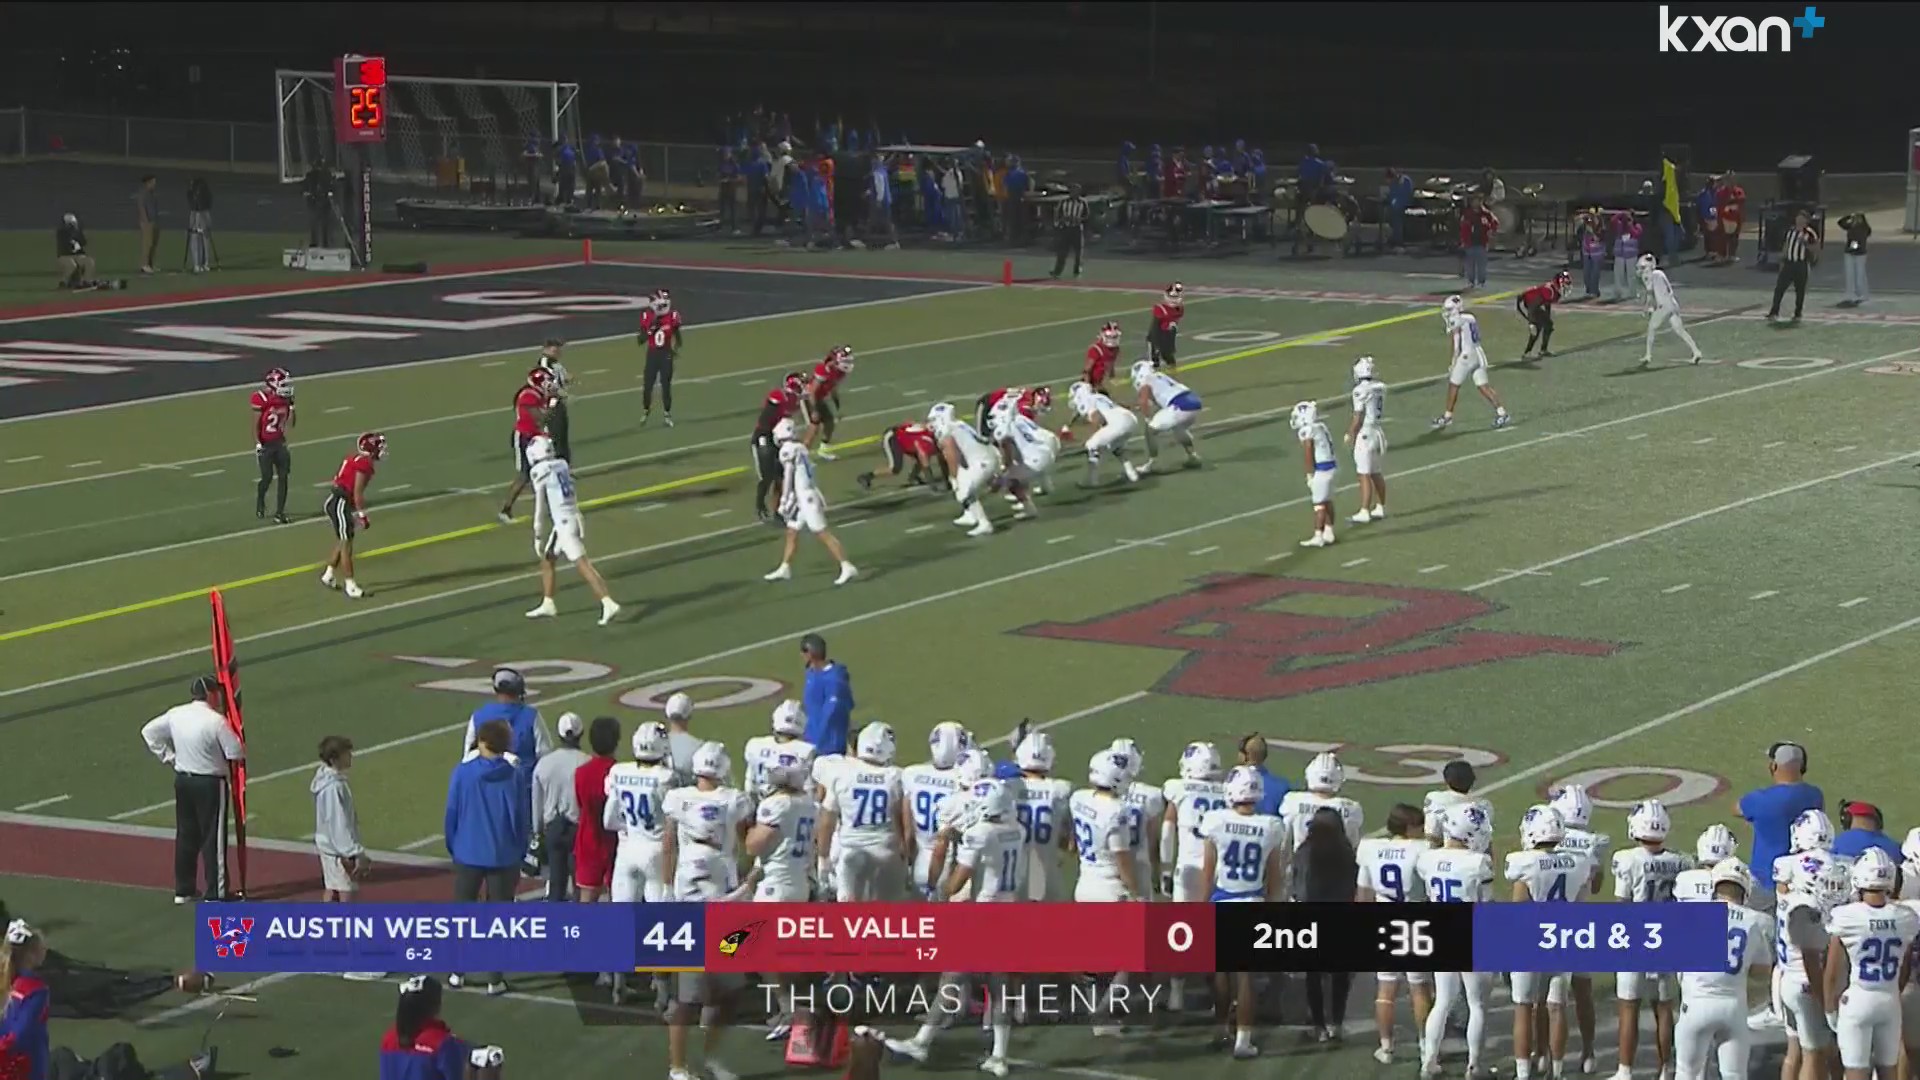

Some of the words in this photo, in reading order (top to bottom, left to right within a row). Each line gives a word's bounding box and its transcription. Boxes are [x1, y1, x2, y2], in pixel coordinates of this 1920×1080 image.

[351, 88, 382, 128] 25
[654, 329, 665, 347] 0
[621, 791, 655, 831] 34
[853, 788, 888, 828] 78
[1000, 849, 1018, 891] 11
[1223, 840, 1263, 881] 48
[1378, 849, 1406, 860] WHITE
[1380, 863, 1406, 901] 9
[1546, 873, 1568, 902] 4
[1859, 937, 1902, 982] 26
